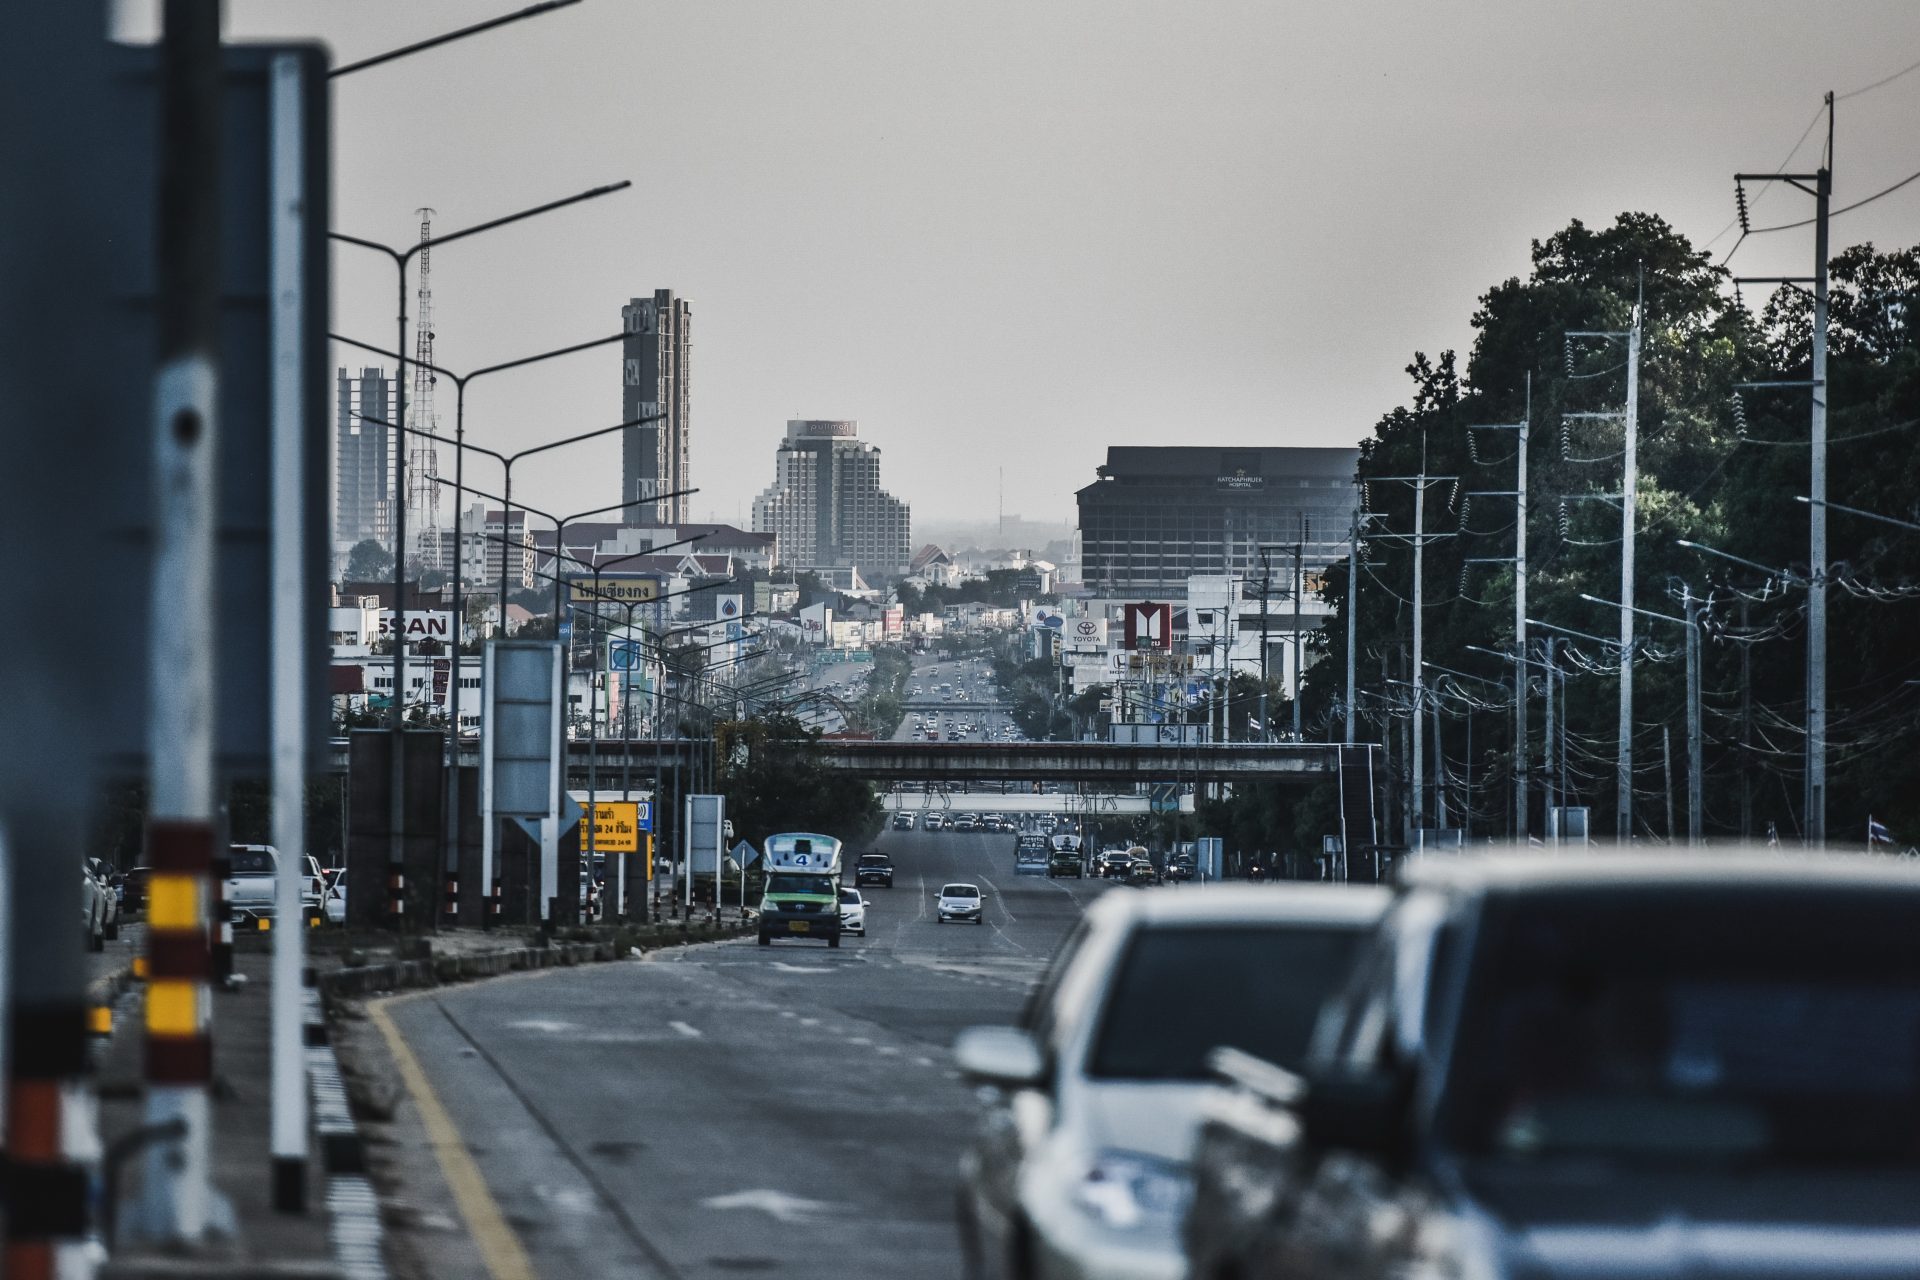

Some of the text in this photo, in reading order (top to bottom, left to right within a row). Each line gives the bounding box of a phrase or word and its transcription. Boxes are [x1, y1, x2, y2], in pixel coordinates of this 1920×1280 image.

[1073, 635, 1101, 643] TOYOTA
[605, 824, 614, 834] 24
[795, 855, 808, 866] 4
